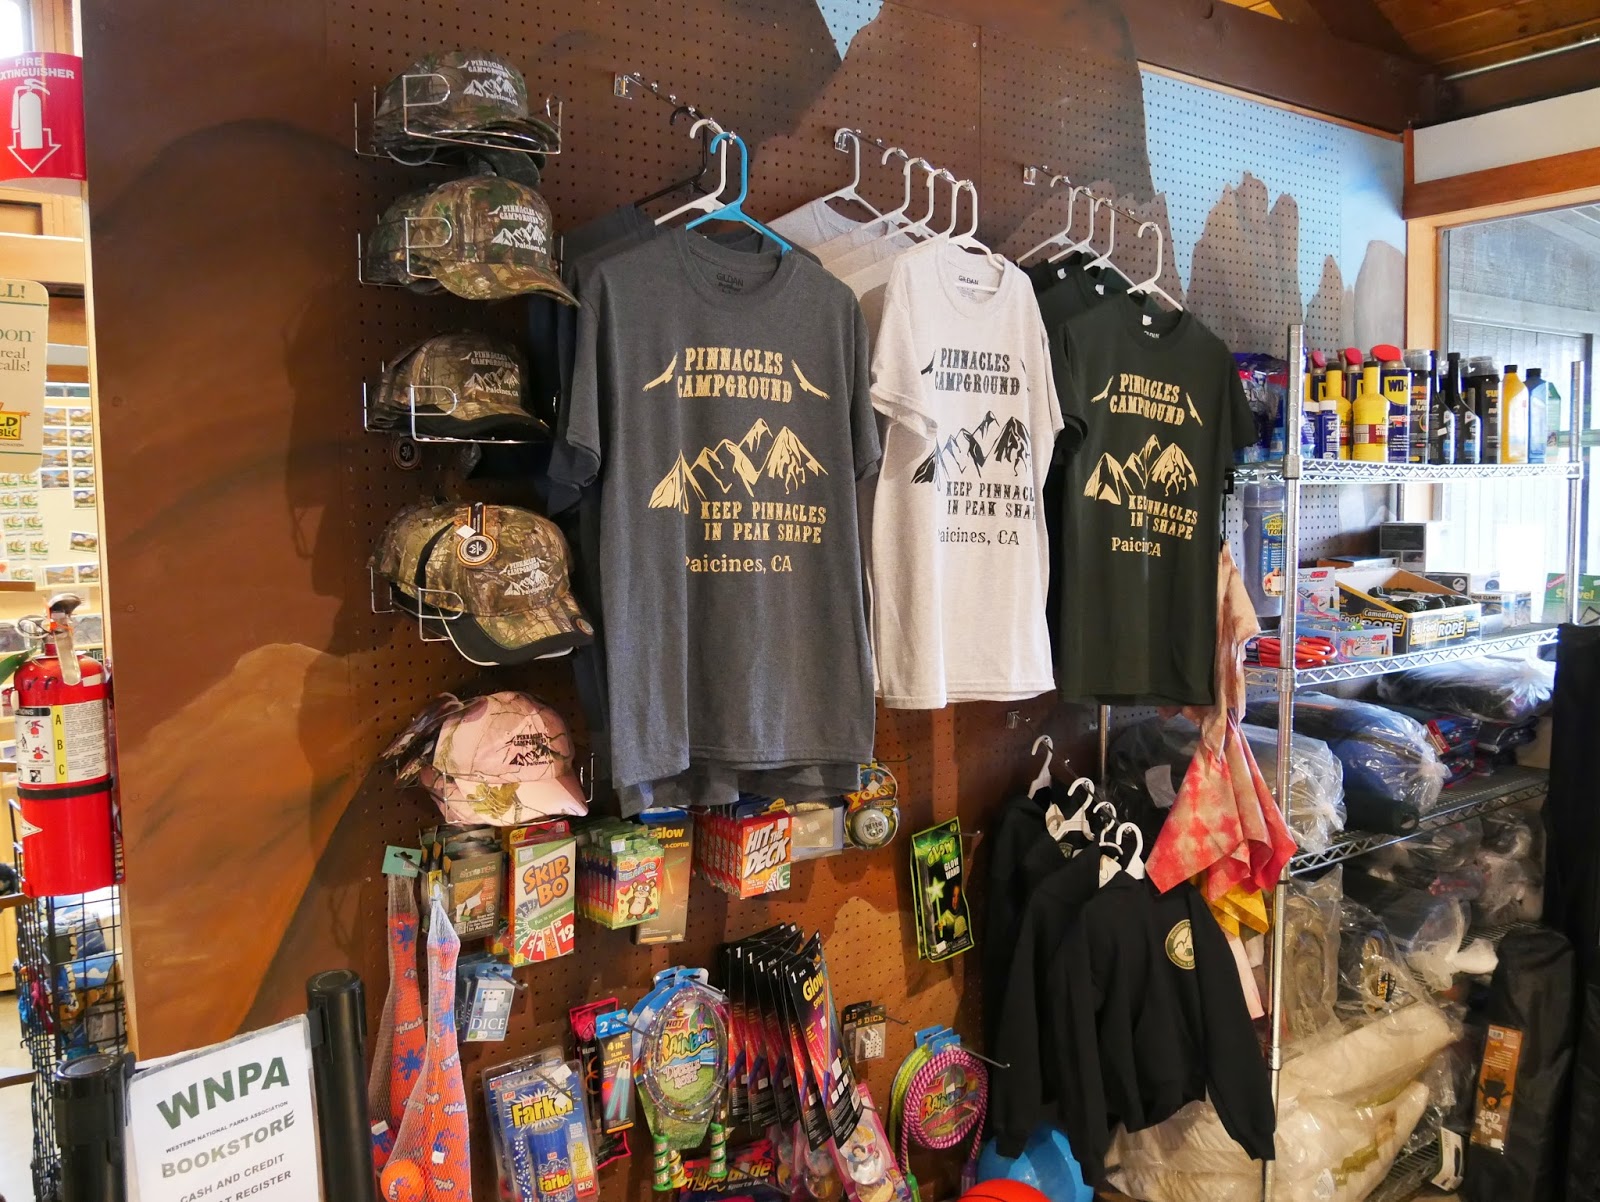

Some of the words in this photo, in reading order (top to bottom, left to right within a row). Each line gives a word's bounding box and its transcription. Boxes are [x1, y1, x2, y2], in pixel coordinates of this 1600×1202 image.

[15, 57, 43, 66] FIRE
[0, 68, 75, 80] XTINGUISHER
[684, 347, 783, 376] PINNACLES
[940, 347, 1011, 373] PINNACLES
[677, 374, 793, 403] CAMPGROUND
[934, 371, 1021, 396] CAMPGROUND
[1109, 395, 1185, 426] CAMPROUND
[946, 481, 973, 497] KEEP
[979, 482, 1035, 502] PINNACL
[701, 501, 743, 520] KEEP
[752, 502, 827, 524] PINNACLES
[947, 500, 959, 515] IN
[965, 500, 996, 516] PEAK
[1005, 503, 1036, 520] SHA
[1146, 499, 1198, 525] NNACLES
[704, 522, 722, 541] IN
[733, 522, 770, 541] PEAK
[777, 523, 822, 544] SHAPE
[1131, 512, 1143, 527] IN
[1153, 517, 1194, 540] SHAPE
[997, 529, 1020, 545] CA
[1111, 536, 1148, 553] Paici
[771, 555, 793, 572] CA
[1364, 608, 1404, 620] Camouflage
[1422, 622, 1437, 632] Foot
[1438, 620, 1465, 637] ROPE
[55, 714, 62, 725] A
[57, 740, 63, 750] B
[59, 764, 65, 775] C
[846, 785, 893, 810] YOO!
[656, 827, 685, 839] Glow
[745, 822, 775, 855] HIT
[770, 827, 786, 843] THE
[742, 837, 790, 879] DECK
[943, 857, 959, 872] GLOW
[618, 861, 657, 881] HEARTS
[945, 865, 960, 880] WAND
[558, 924, 575, 943] 12
[791, 971, 797, 984] 1
[803, 970, 824, 1001] Glow
[471, 1018, 506, 1030] DICE
[600, 1021, 608, 1033] 2
[864, 1014, 884, 1024] DICE
[607, 1041, 614, 1051] 4
[156, 1056, 290, 1130] WNPA
[510, 1090, 575, 1128] Farkl
[166, 1138, 196, 1154] WESTERN
[197, 1125, 228, 1142] NATIONAL
[229, 1116, 249, 1129] PARKS
[250, 1100, 289, 1120] ASSOCIATION
[161, 1110, 295, 1179] BOOKSTORE
[180, 1184, 213, 1202] CASH
[216, 1173, 241, 1190] AND
[244, 1153, 285, 1177] CREDIT
[235, 1170, 292, 1200] REGISTER
[538, 1170, 572, 1192] Farkel
